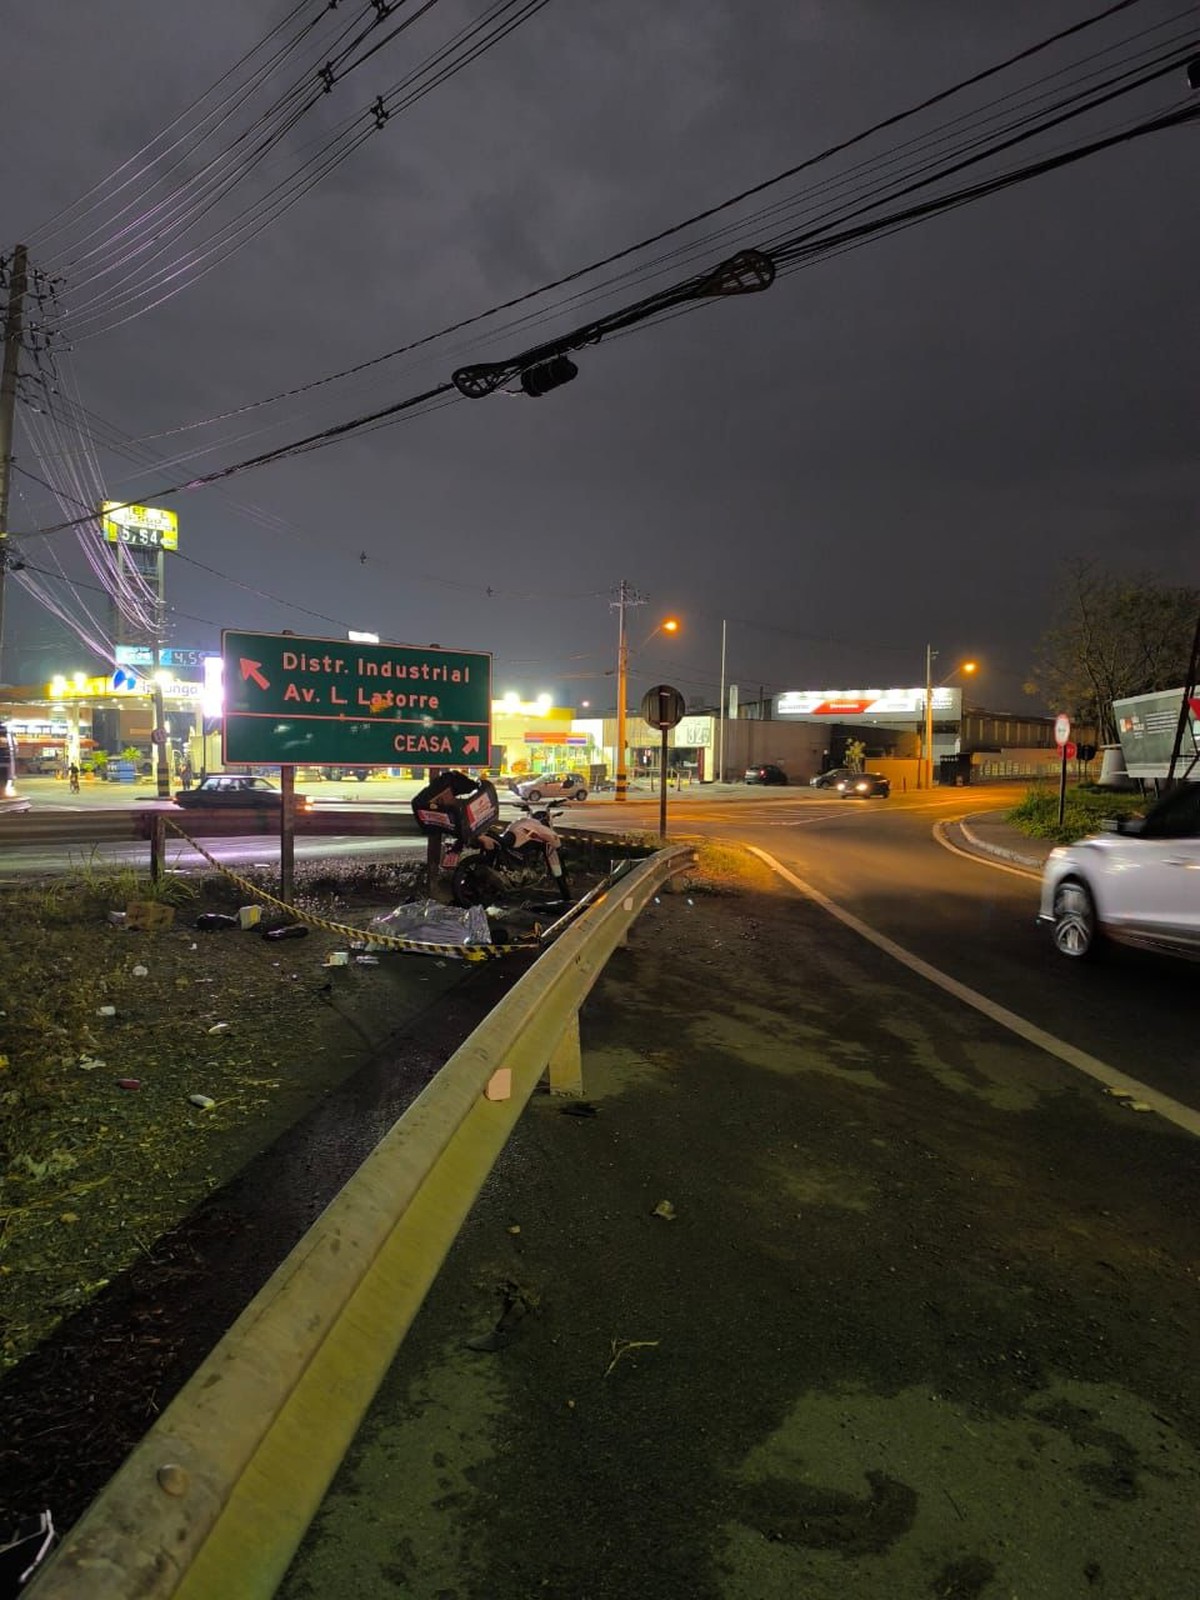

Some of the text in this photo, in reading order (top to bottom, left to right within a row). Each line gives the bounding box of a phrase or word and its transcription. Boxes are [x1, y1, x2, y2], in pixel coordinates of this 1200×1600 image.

[282, 652, 470, 684] Distr. Industrial
[284, 683, 321, 703] Av.
[357, 687, 440, 710] Latorre
[394, 735, 453, 753] CEASA
